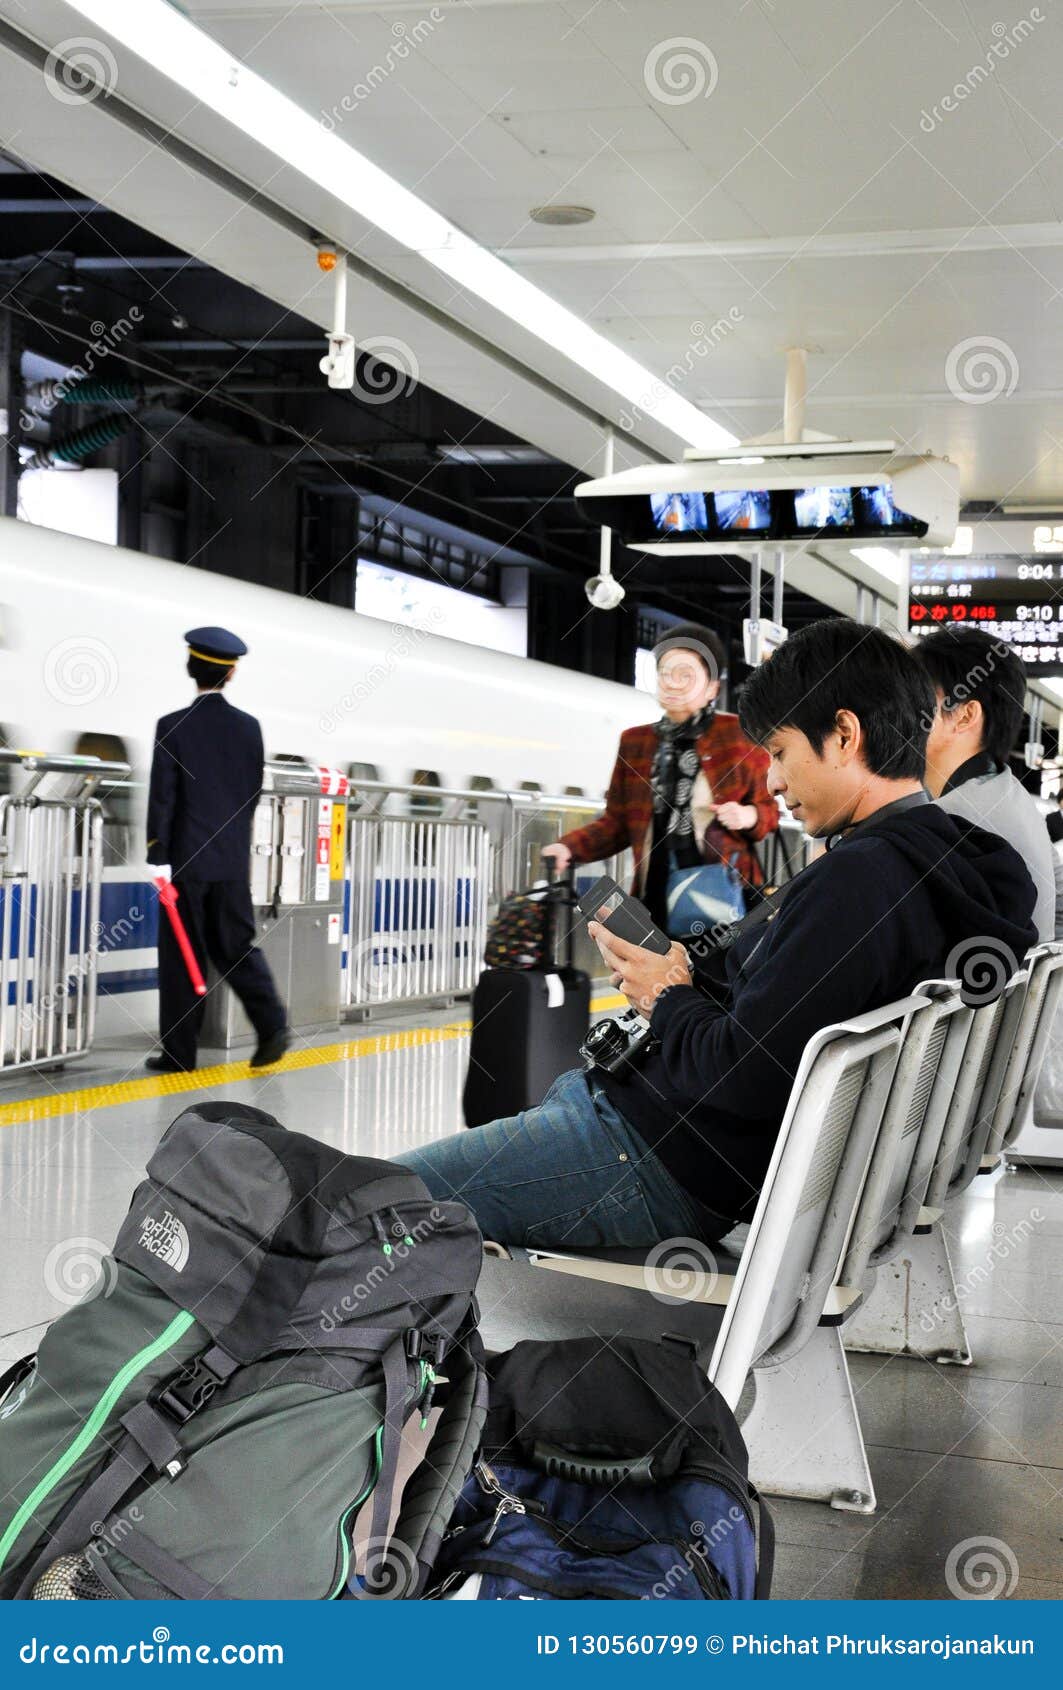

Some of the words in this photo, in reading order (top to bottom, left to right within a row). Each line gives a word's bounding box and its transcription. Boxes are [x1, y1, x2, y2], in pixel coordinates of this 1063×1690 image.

[1017, 564, 1053, 580] 9:04
[910, 604, 967, 621] ひかり
[1016, 605, 1053, 621] 9:10
[140, 1215, 177, 1247] NORTH
[161, 1210, 181, 1234] THE
[137, 1231, 170, 1259] FACE
